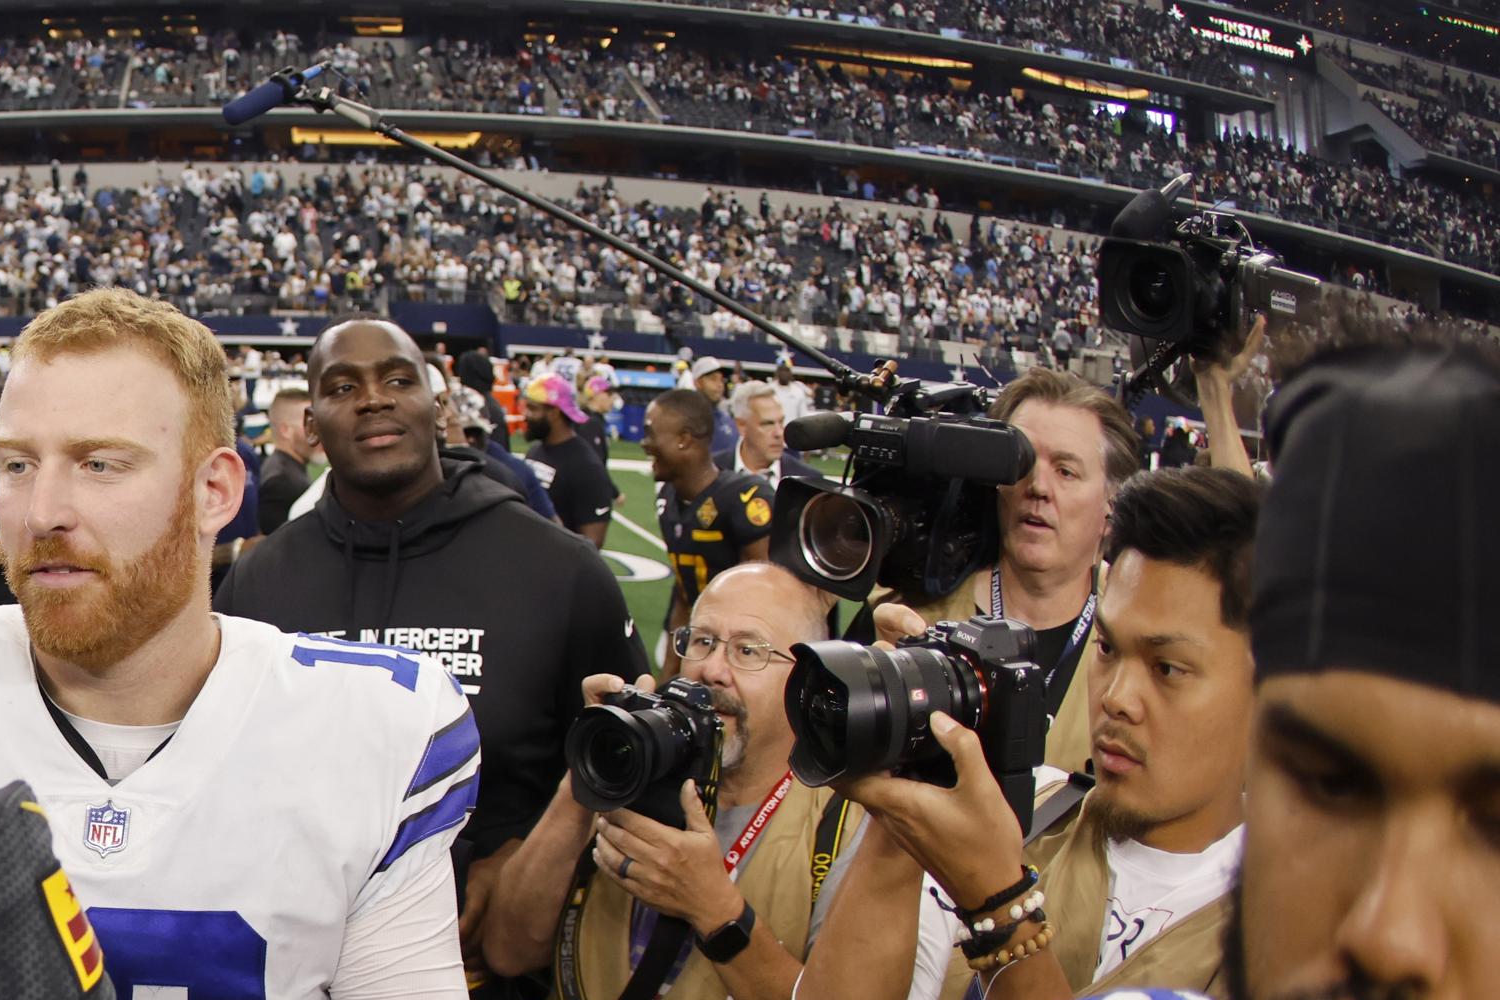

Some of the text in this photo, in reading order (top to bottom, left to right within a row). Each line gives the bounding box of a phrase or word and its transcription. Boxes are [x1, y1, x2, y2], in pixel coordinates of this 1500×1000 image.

[1222, 33, 1255, 49] CASINO
[1263, 43, 1295, 58] RESORT
[956, 630, 978, 644] SONY
[667, 686, 689, 698] Nikon
[740, 826, 758, 849] AT&T
[752, 796, 780, 829] COTTON
[90, 823, 121, 847] NFL
